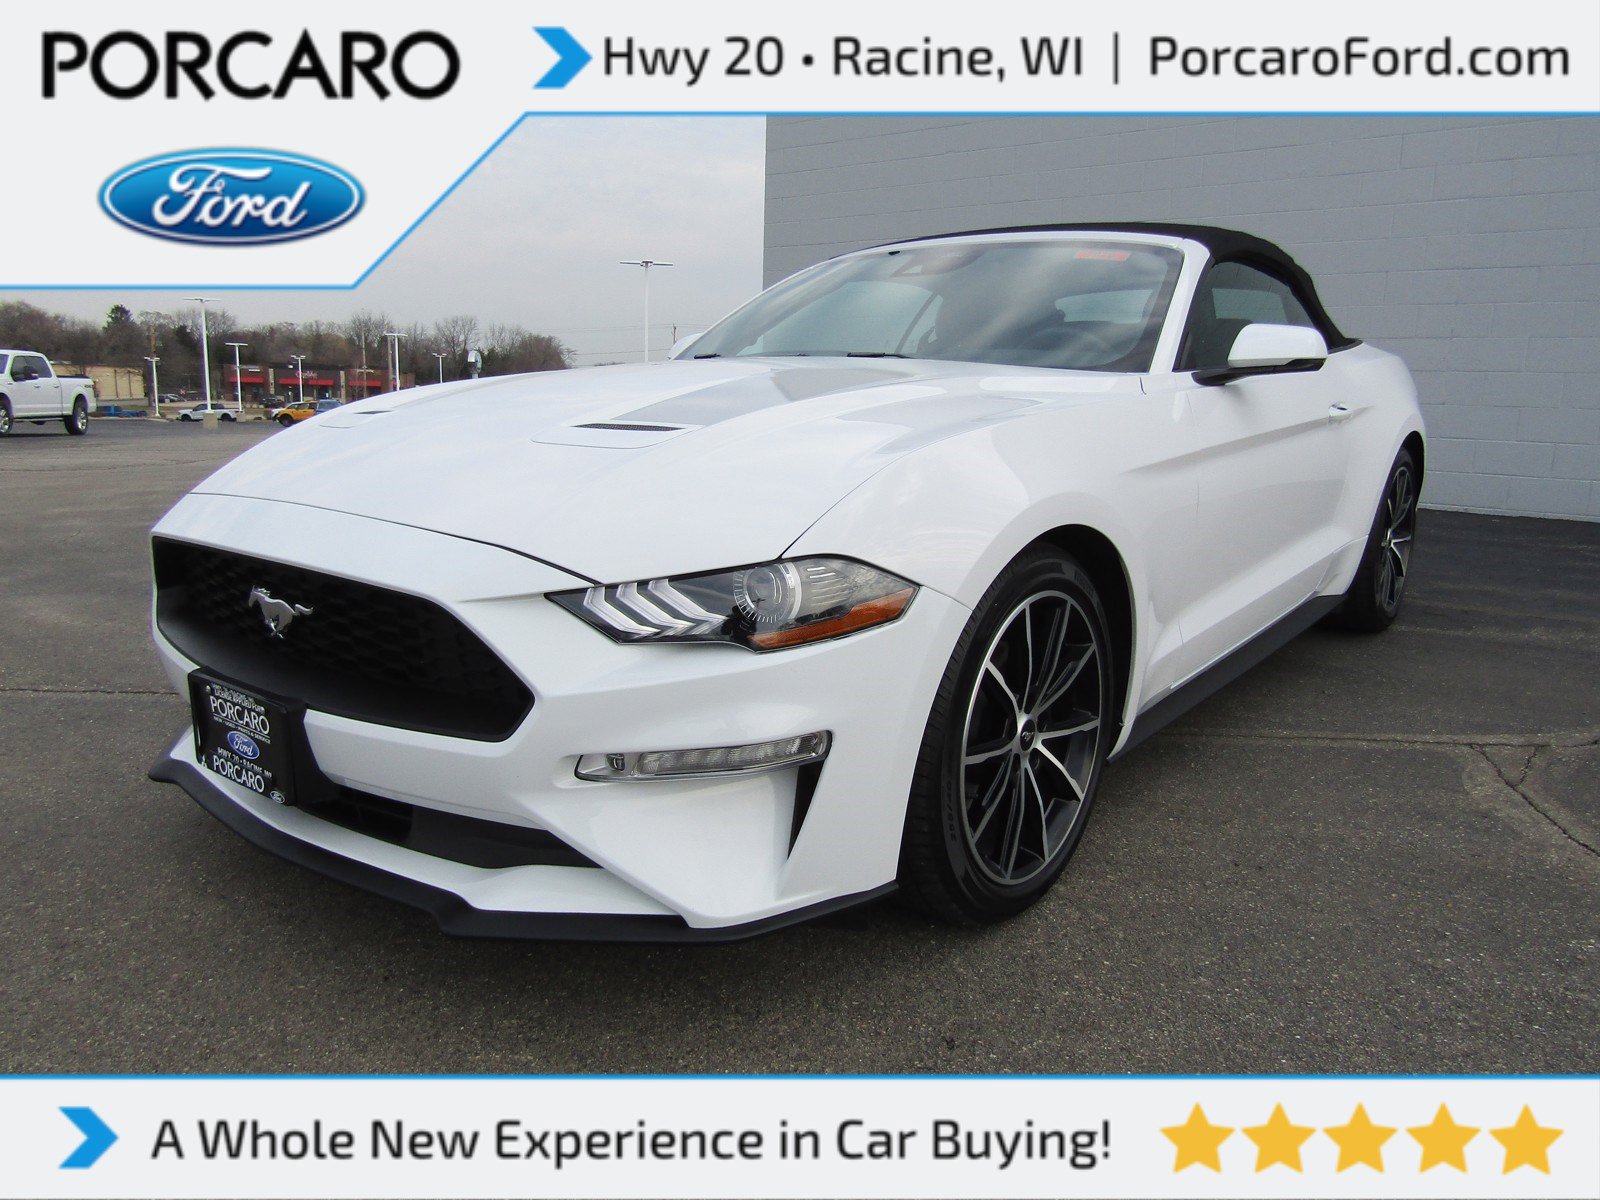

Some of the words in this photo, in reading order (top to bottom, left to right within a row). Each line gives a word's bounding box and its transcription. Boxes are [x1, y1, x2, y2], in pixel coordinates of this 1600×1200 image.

[210, 695, 270, 735] PORCARO
[217, 746, 232, 760] HWY
[232, 733, 254, 757] Ford
[213, 754, 265, 794] PORCARO
